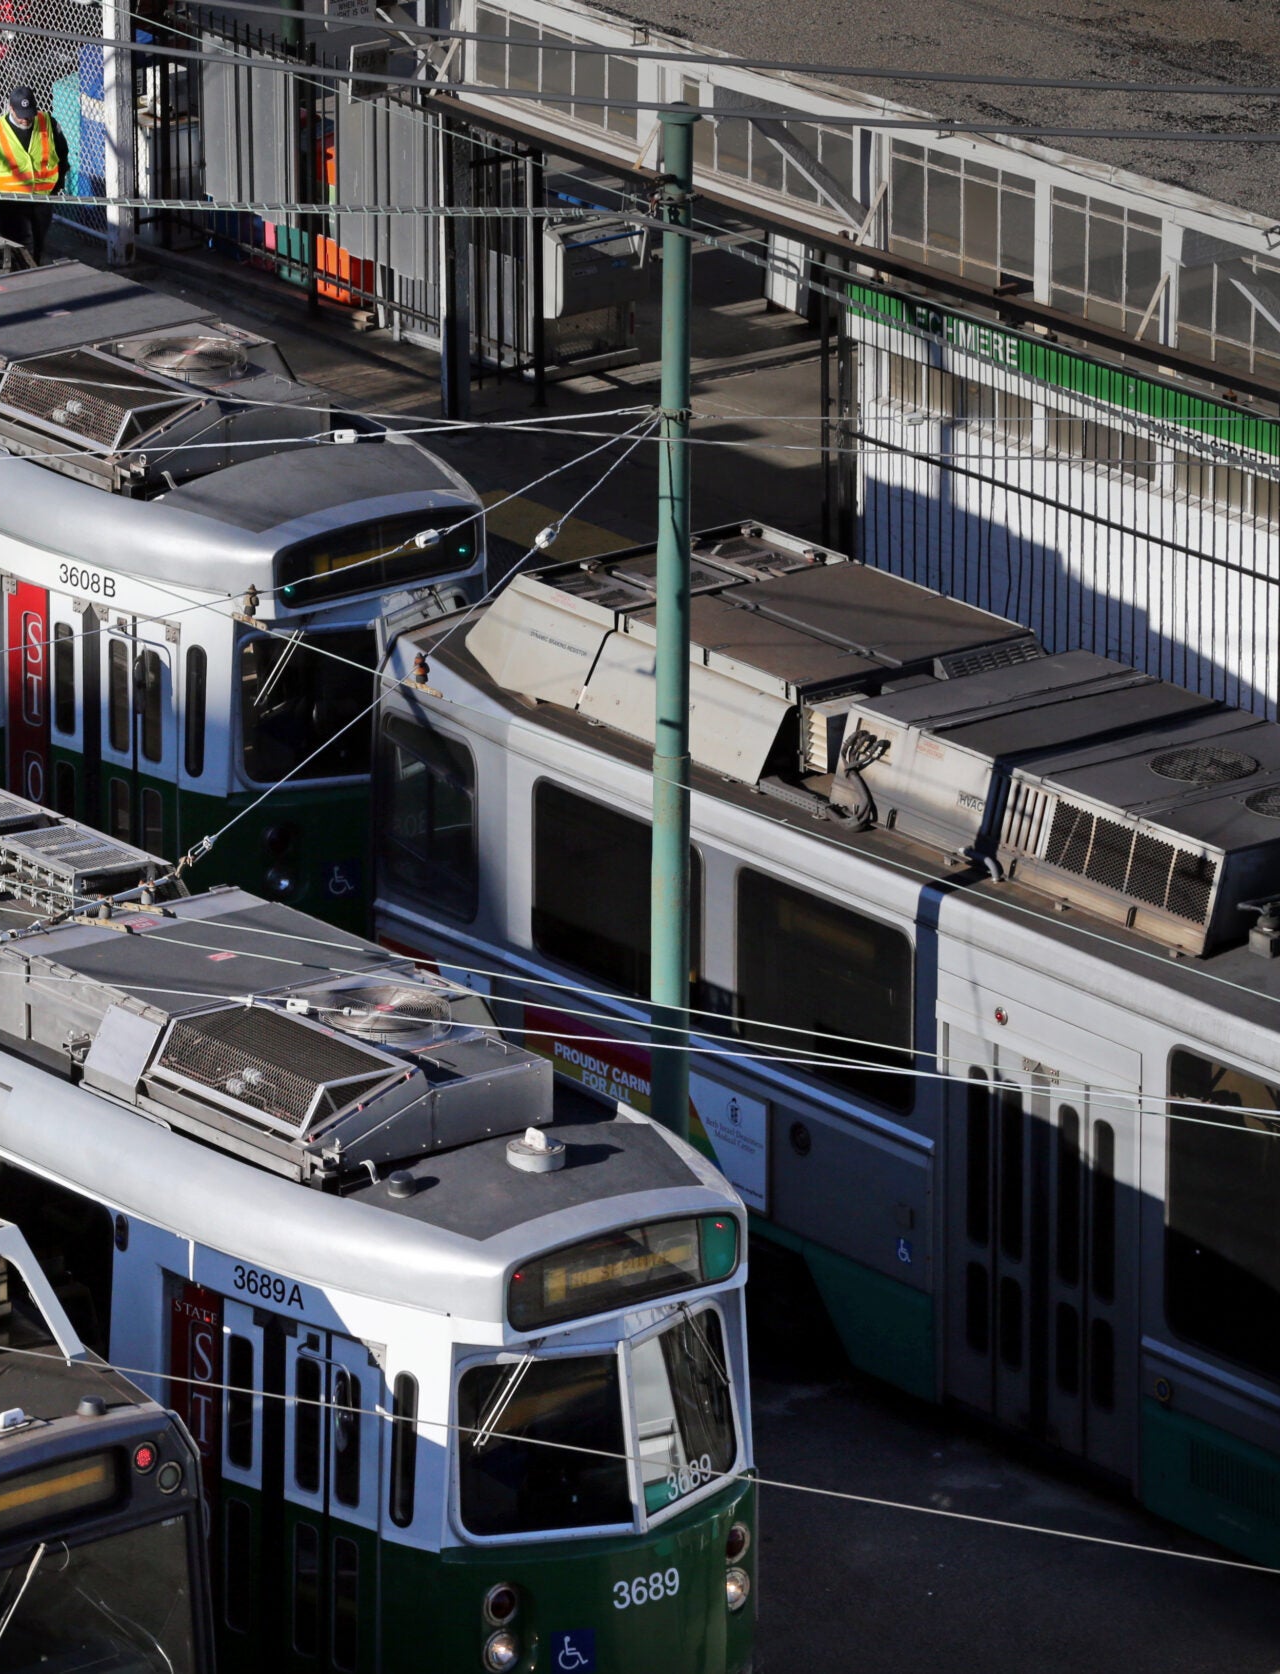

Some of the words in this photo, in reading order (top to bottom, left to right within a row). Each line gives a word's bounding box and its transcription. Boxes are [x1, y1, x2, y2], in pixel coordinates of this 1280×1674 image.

[59, 563, 116, 598] 3608B
[959, 794, 984, 812] HVAC
[554, 1041, 611, 1077] PROUDLY
[612, 1066, 651, 1096] CARIN
[582, 1069, 607, 1092] FOR
[609, 1083, 631, 1104] ALL
[233, 1265, 304, 1311] 3689A
[174, 1299, 218, 1326] STATE
[666, 1453, 712, 1500] 3689
[612, 1567, 680, 1609] 3689
